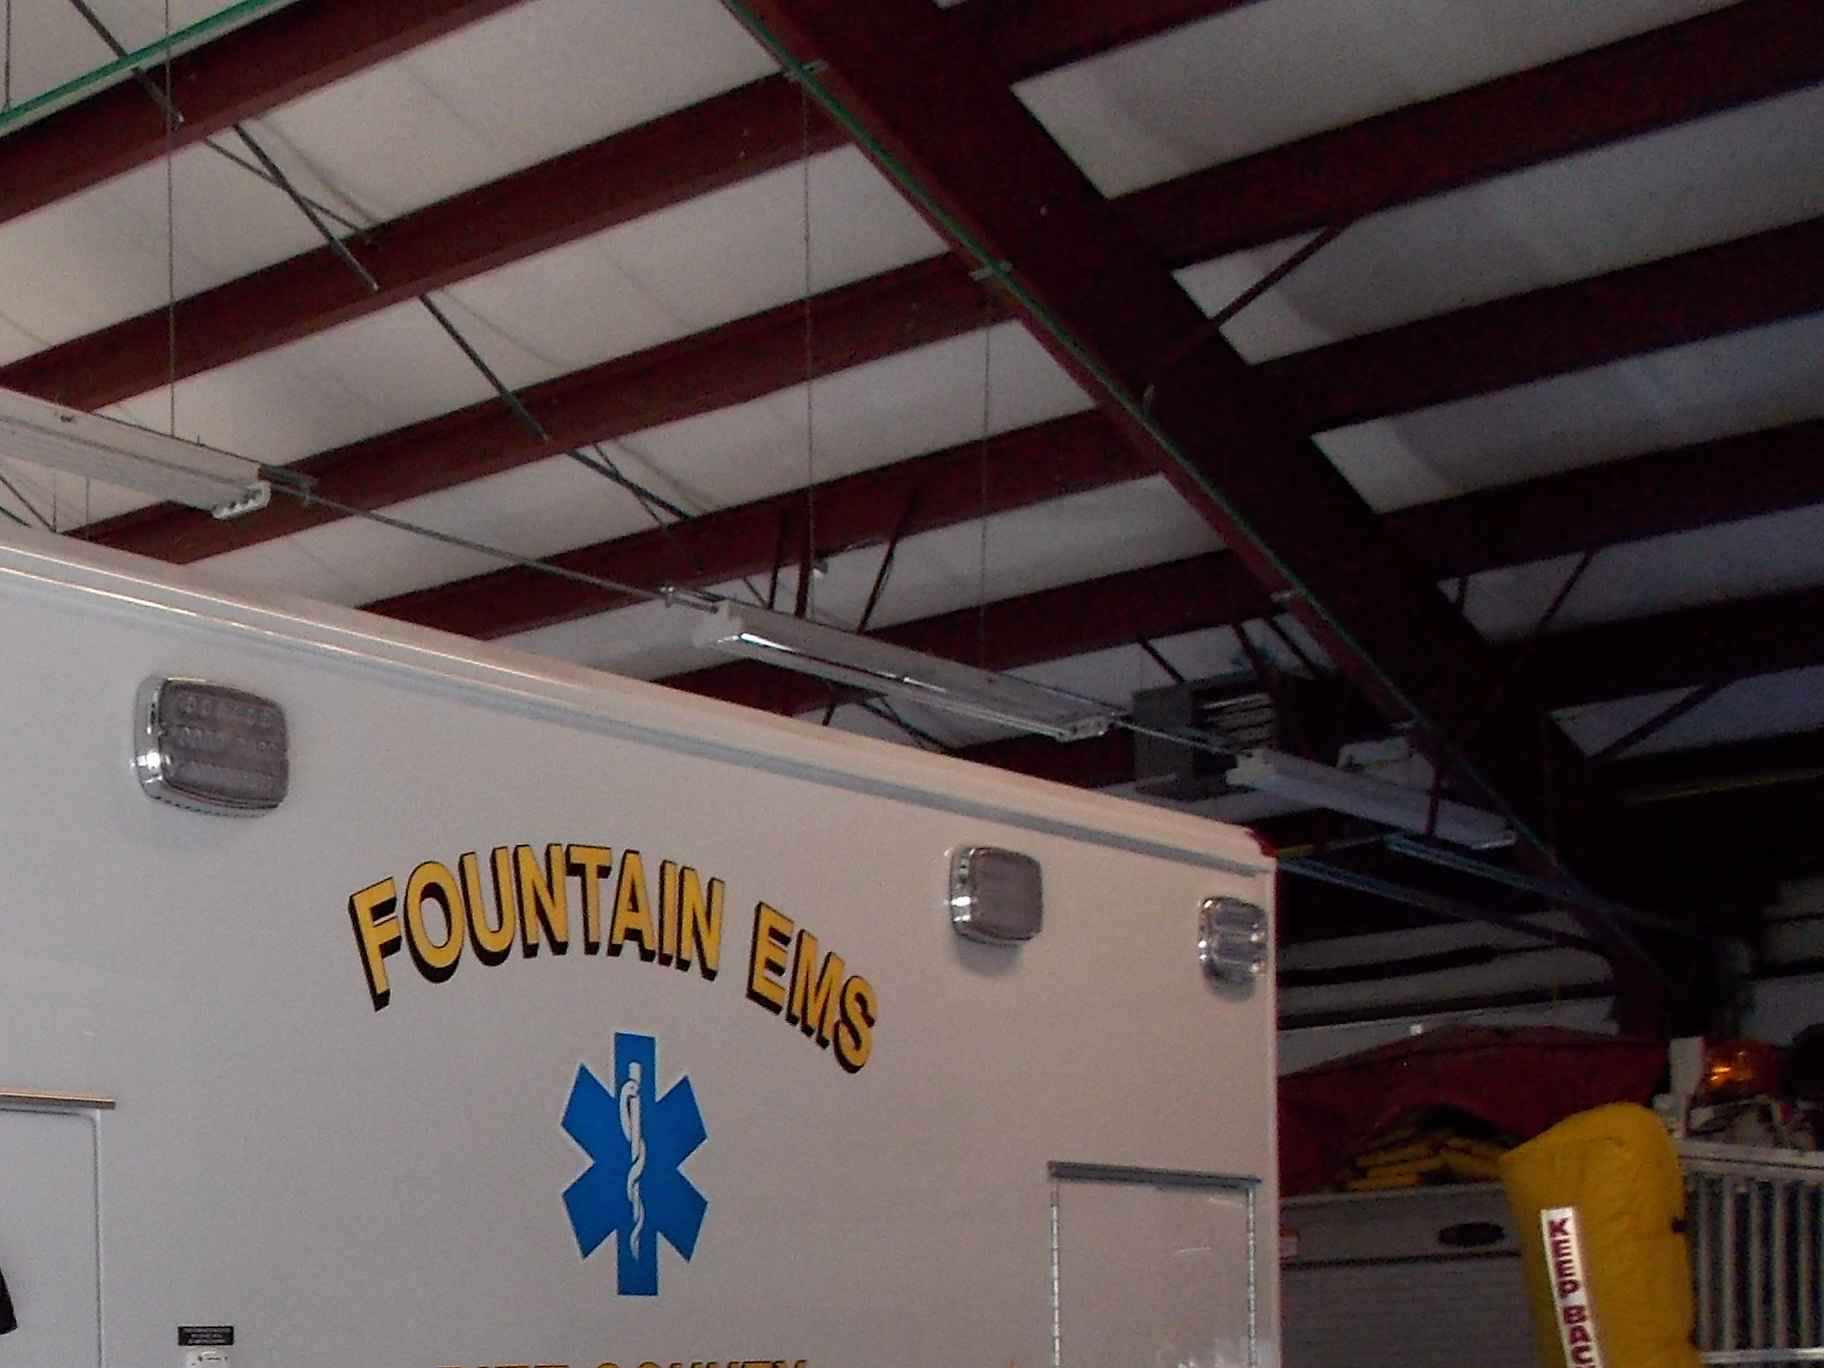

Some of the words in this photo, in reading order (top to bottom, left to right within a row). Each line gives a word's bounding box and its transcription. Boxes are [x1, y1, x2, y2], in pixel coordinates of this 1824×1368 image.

[347, 842, 725, 1012] FOUNTAIN
[745, 901, 878, 1074] EMS
[1548, 1217, 1580, 1299] KEEP
